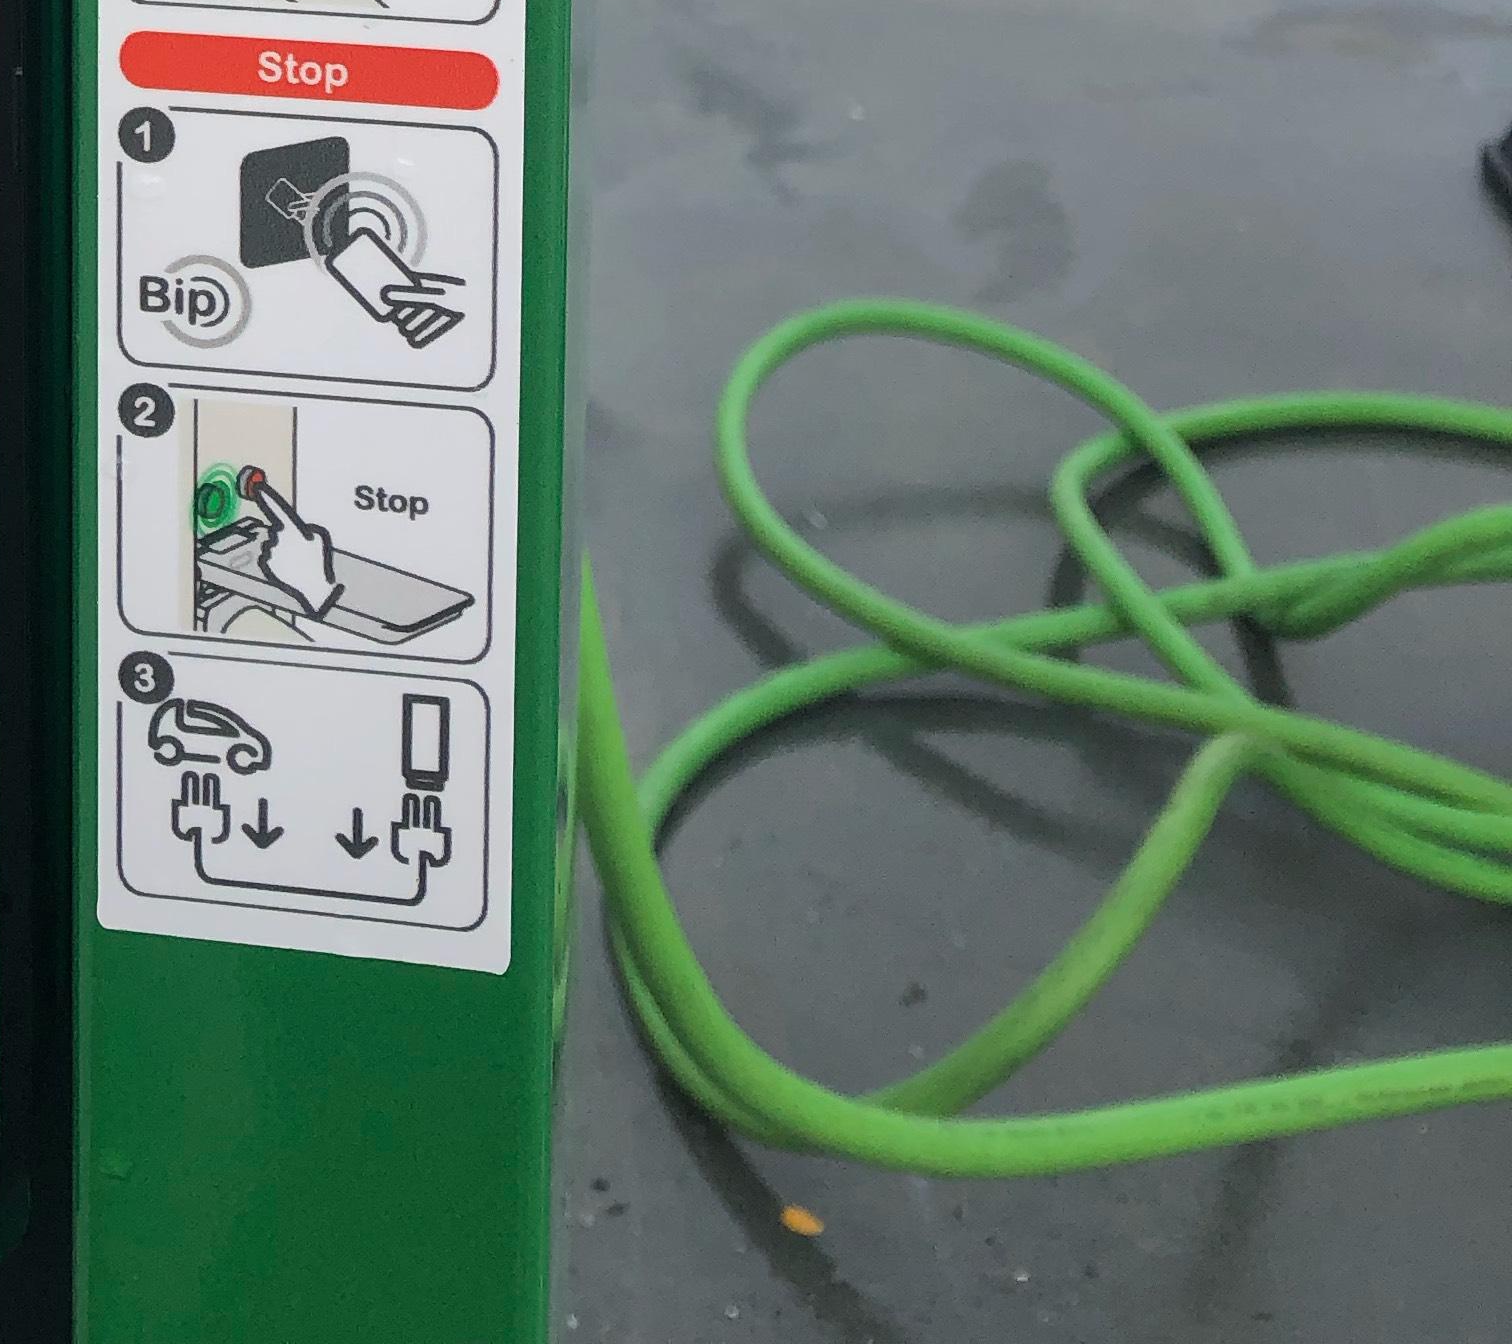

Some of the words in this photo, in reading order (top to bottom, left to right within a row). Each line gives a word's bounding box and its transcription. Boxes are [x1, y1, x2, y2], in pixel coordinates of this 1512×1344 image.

[257, 51, 350, 90] Stop
[134, 120, 152, 152] 1
[139, 274, 217, 325] Bip
[133, 396, 156, 427] 2
[352, 483, 430, 521] Stop
[133, 662, 156, 693] 3
